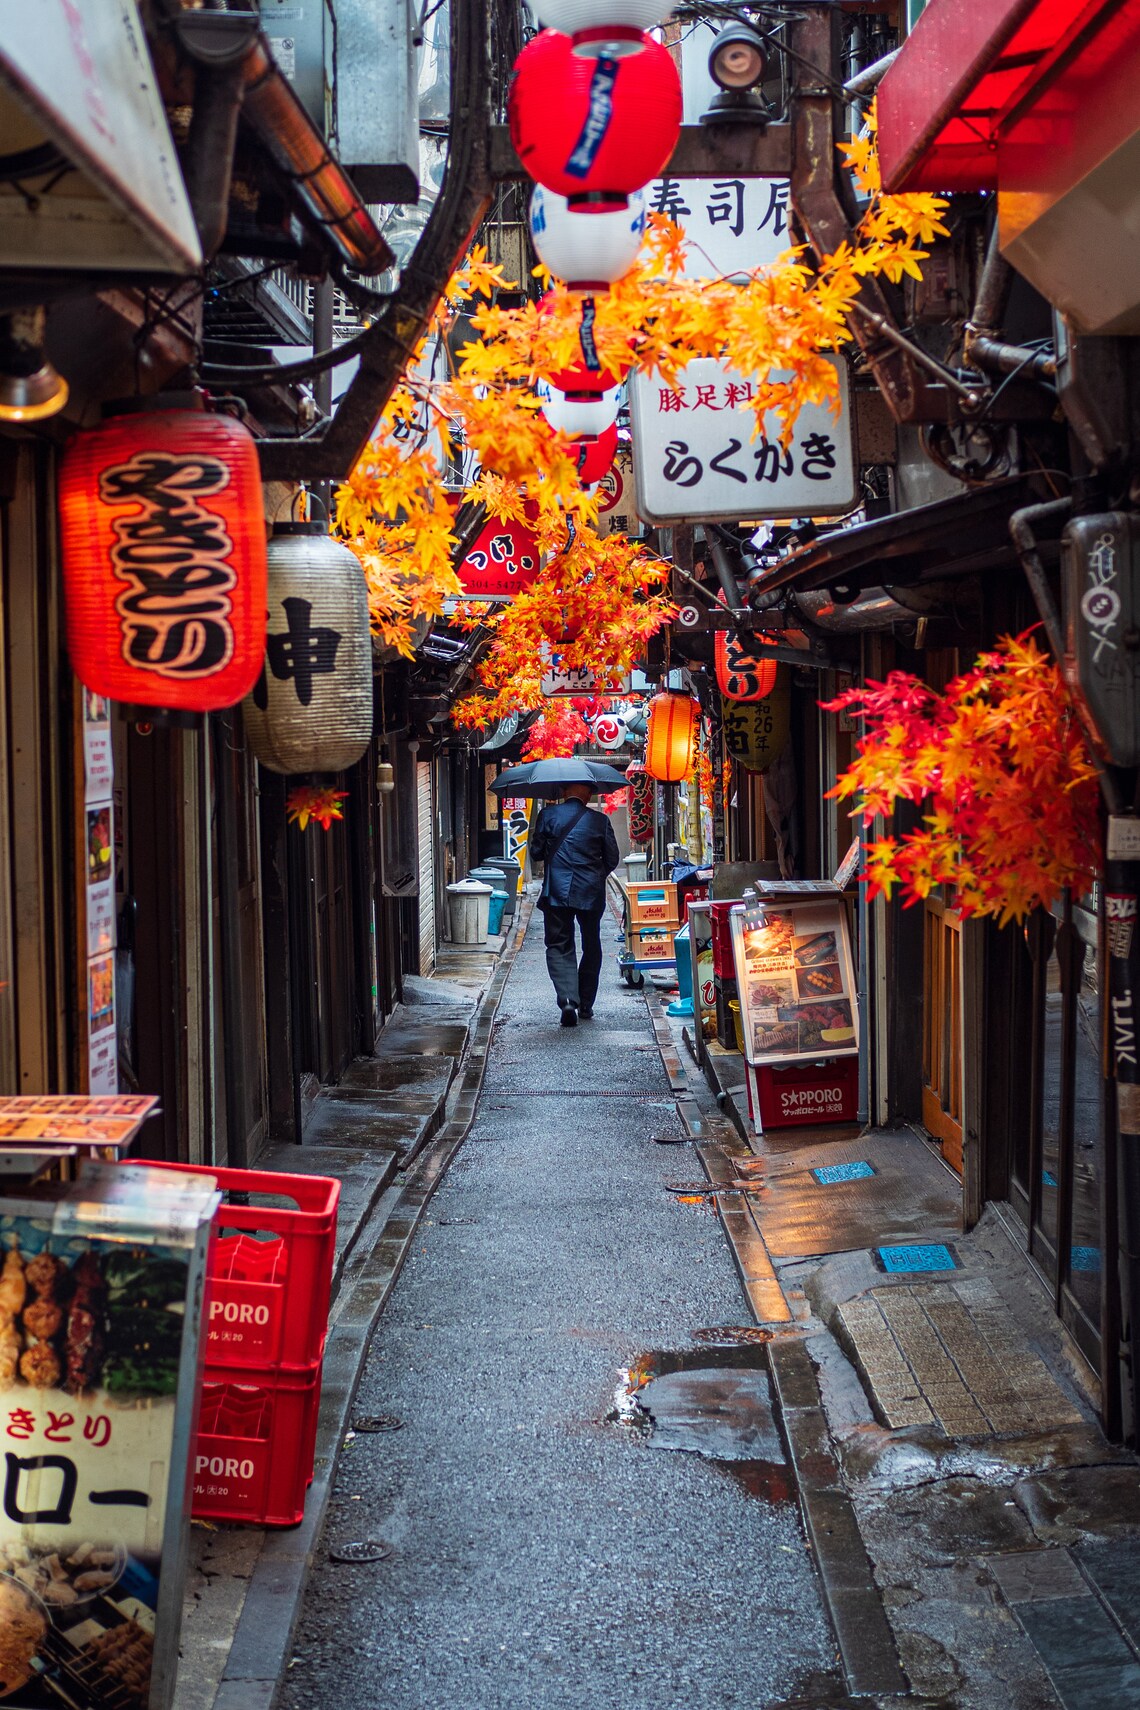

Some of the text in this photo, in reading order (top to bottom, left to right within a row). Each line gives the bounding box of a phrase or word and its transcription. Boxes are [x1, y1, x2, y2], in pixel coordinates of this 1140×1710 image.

[659, 382, 794, 412] 豚足料
[463, 580, 522, 589] 304-5477
[753, 697, 774, 753] 和26年
[781, 1088, 842, 1107] SAPPORO
[7, 1408, 111, 1447] きとり
